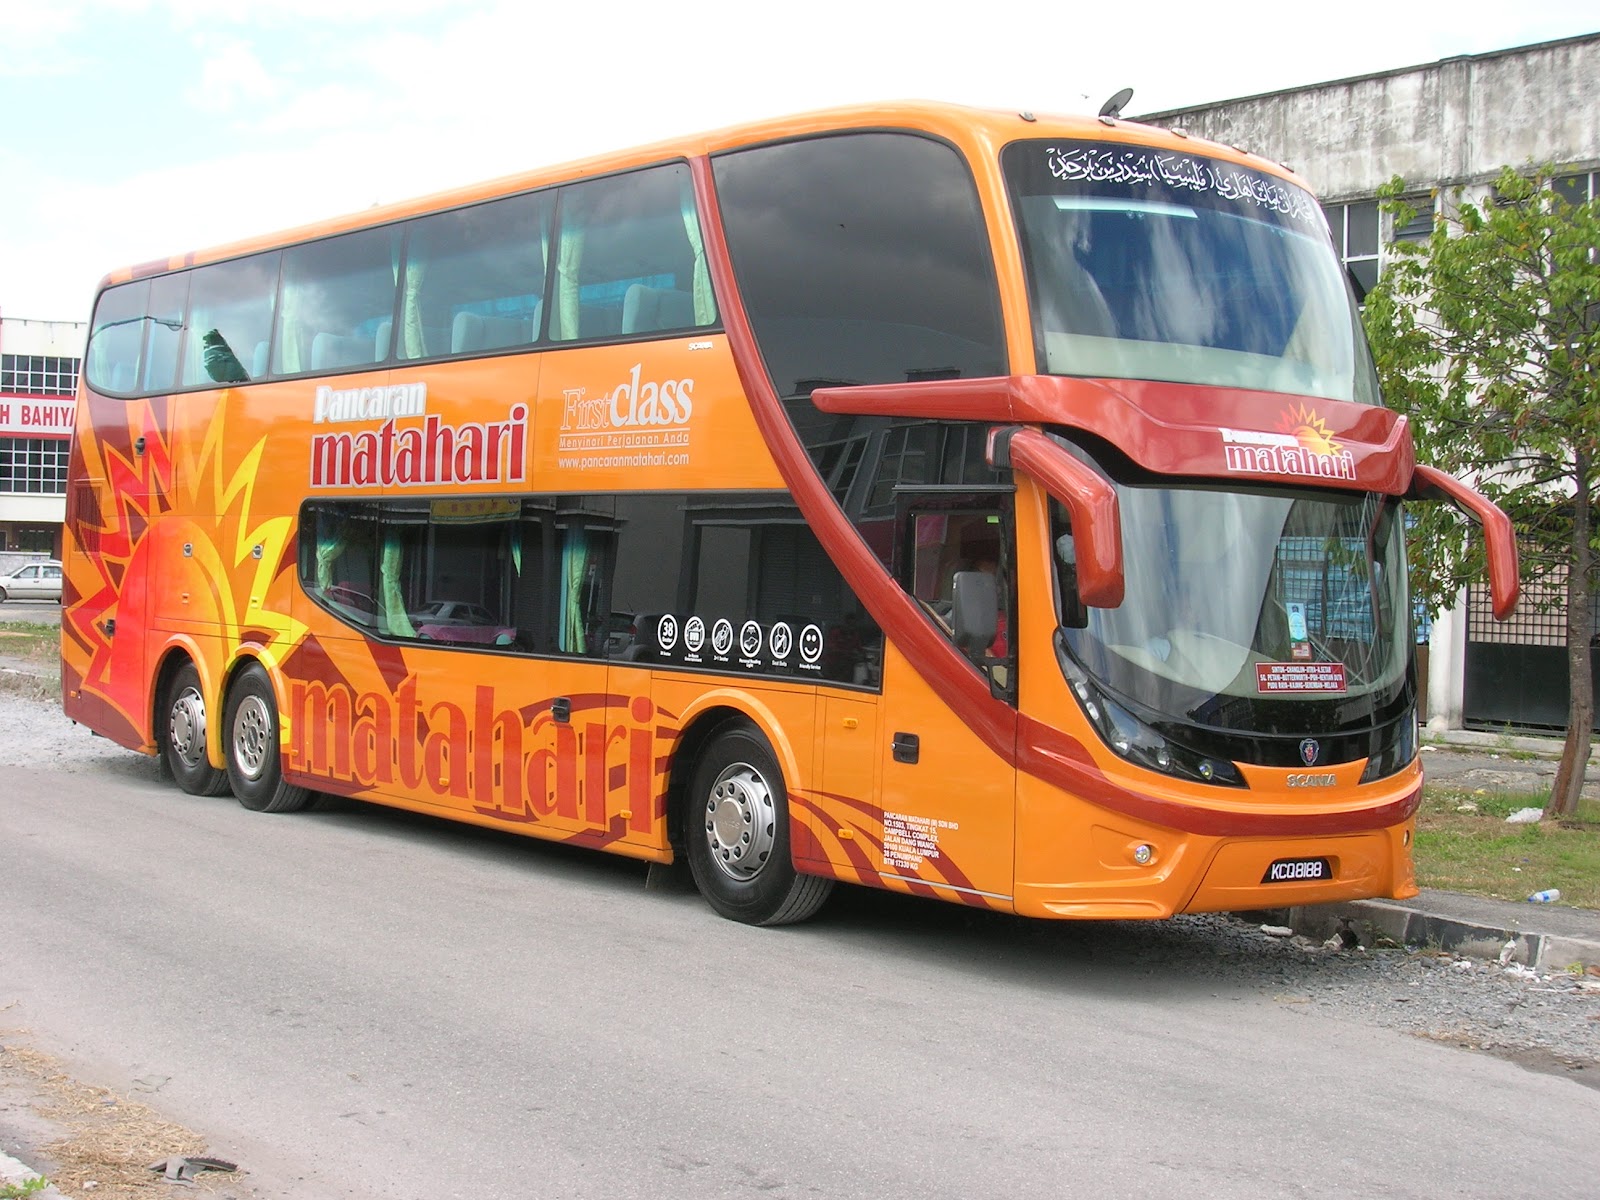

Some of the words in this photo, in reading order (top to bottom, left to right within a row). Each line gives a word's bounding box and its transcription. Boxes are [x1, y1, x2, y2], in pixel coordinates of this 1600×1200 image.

[313, 382, 427, 424] Pancaran
[310, 403, 529, 488] matahari
[559, 436, 603, 450] Menyinari
[607, 433, 659, 449] Perjalanan
[663, 431, 689, 444] Anda
[559, 452, 689, 471] www.pancaranmatahari.com
[1225, 445, 1357, 481] matahari
[662, 621, 674, 637] 38
[290, 672, 655, 836] matahari
[1286, 773, 1337, 788] SCANIA
[884, 827, 911, 838] CAMPBELL
[906, 822, 928, 833] TINGKAT
[884, 835, 900, 844] JALAN
[901, 838, 917, 847] DANG
[890, 851, 923, 863] PENUMPANG
[898, 844, 917, 855] KUALA
[917, 847, 940, 858] LUMPUR
[910, 862, 919, 870] KG
